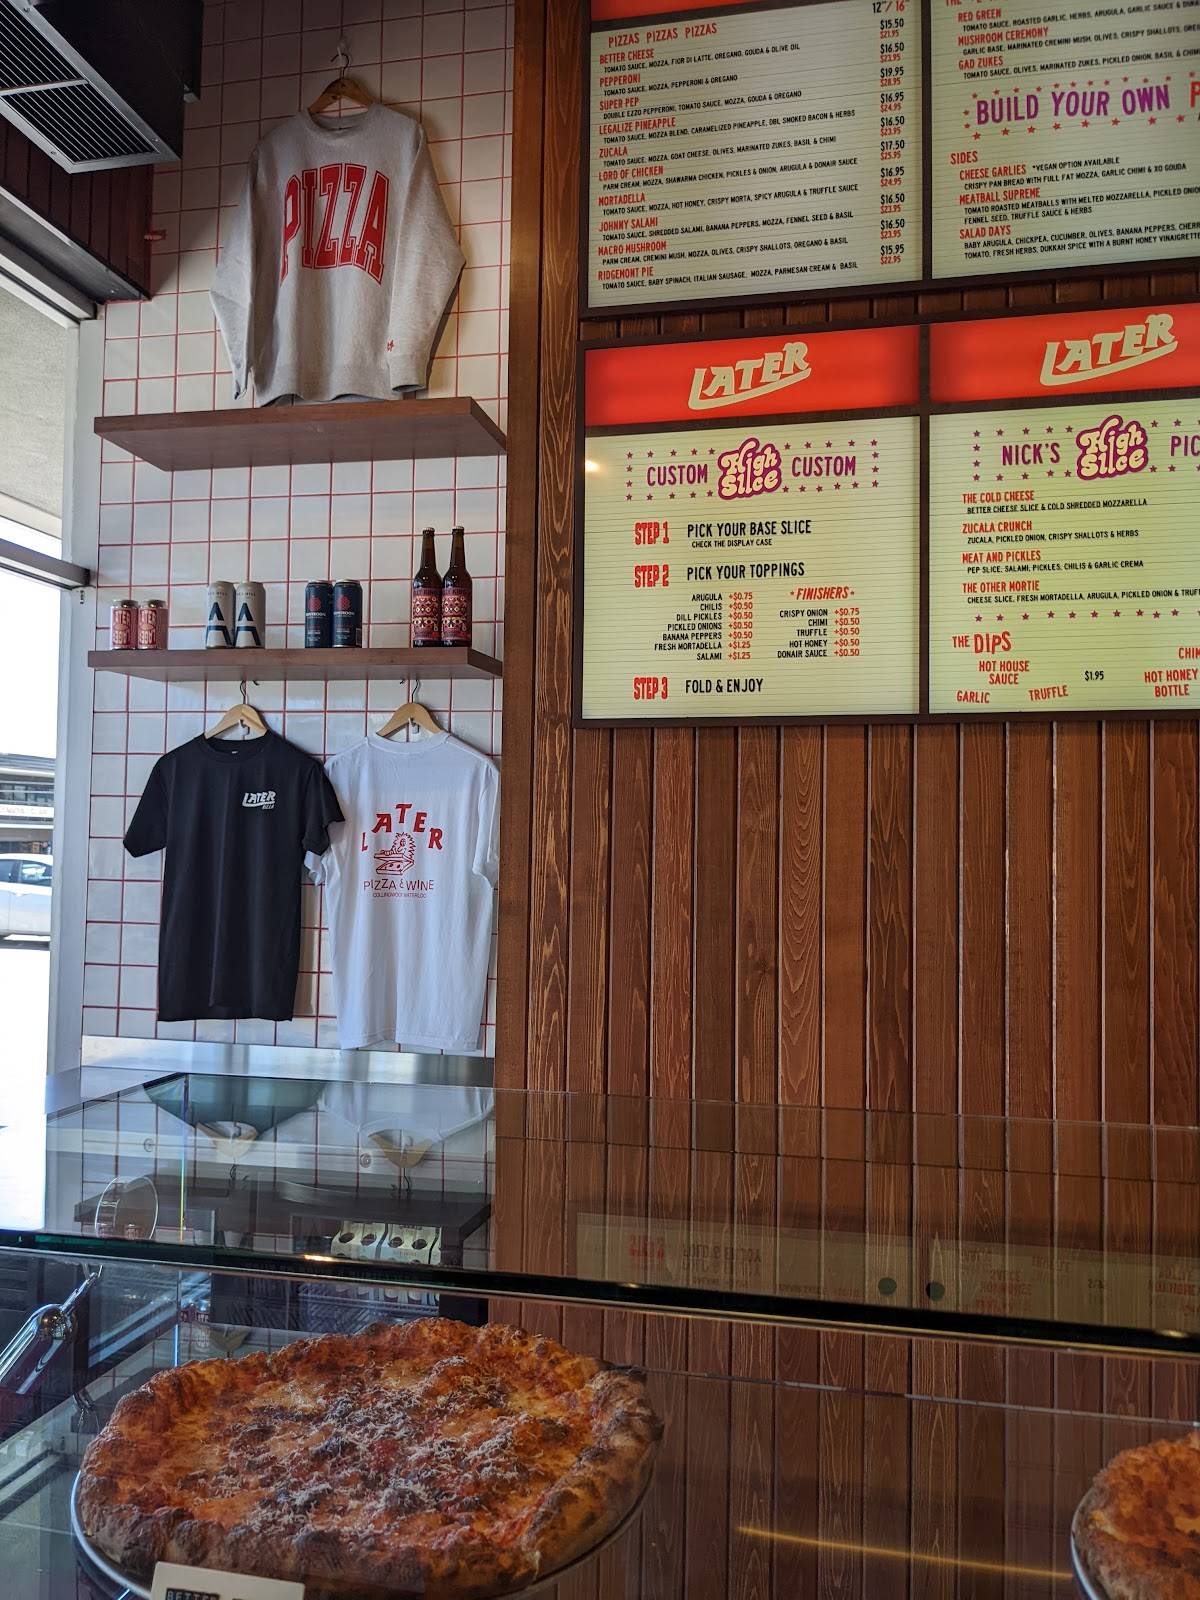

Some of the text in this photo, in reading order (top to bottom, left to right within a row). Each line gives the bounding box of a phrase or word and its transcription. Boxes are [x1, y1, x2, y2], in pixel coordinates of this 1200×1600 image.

[880, 18, 904, 29] $15.50
[608, 23, 717, 48] PIZZAS PIZZAS PIZZAS
[599, 48, 654, 64] BETTER CHEESE
[880, 67, 903, 77] $19.95
[599, 73, 640, 86] PEPPERONI
[977, 85, 1169, 124] BUILD YOUR OWN
[599, 117, 675, 134] LEGALIZE PINEAPPLE
[950, 151, 977, 164] SIDES
[598, 165, 663, 180] LORD OF CHICKEN
[959, 165, 1026, 179] CHEESE GARLIES
[598, 192, 645, 205] MORTADELLA
[959, 188, 1040, 204] MEATBALL SUPREME
[964, 215, 987, 224] FENNEL
[1011, 211, 1039, 220] TRUFFLE
[1042, 209, 1061, 218] SAUCE
[1070, 207, 1092, 215] HERBS
[280, 162, 390, 286] PIZZA
[600, 217, 658, 231] JOHNNY SALAMI
[959, 225, 1010, 239] SALAD DAYS
[598, 266, 653, 280] RIDGEMONT PIE
[1040, 314, 1178, 386] LATER
[688, 342, 812, 410] LATER
[1079, 417, 1143, 455] High
[720, 439, 778, 475] High
[1002, 443, 1060, 466] NICK'S
[791, 456, 856, 477] CUSTOM
[1080, 448, 1145, 477] Slice
[647, 464, 708, 487] CUSTOM
[721, 469, 779, 497] Slice
[963, 491, 1034, 503] THE COLD CHEESE
[967, 506, 991, 514] BETTER
[993, 505, 1017, 513] CHEESE
[1020, 504, 1038, 512] SLICE
[1066, 501, 1100, 510] SHREDDED
[1102, 499, 1147, 508] MOZZARELLA
[634, 521, 669, 545] STEP 1
[687, 521, 811, 537] PICK YOUR BASE SLICE
[962, 521, 1032, 534] ZUCALA CRUNCH
[995, 534, 1023, 543] PICKLED
[1048, 532, 1072, 541] CRISPY
[1074, 531, 1108, 540] SHALLOTS
[1116, 530, 1138, 538] HERBS
[962, 550, 1040, 563] MEAT AND PICKLES
[687, 563, 804, 580] PICK YOUR TOPPINGS
[967, 566, 980, 574] PEP
[1064, 562, 1086, 570] CHILIS
[1094, 561, 1118, 569] GARLIC
[1120, 560, 1143, 568] CREMA
[634, 564, 669, 588] STEP 2
[796, 586, 849, 600] FINISHERS
[963, 581, 1039, 594] THE OTHER MORTIE
[729, 592, 752, 601] +$0.75
[729, 602, 753, 610] +$0.50
[779, 608, 859, 618] CRISPY ONION +$0.75
[729, 612, 752, 620] +$0.50
[808, 617, 859, 627] CHIMI +$0.50
[728, 621, 752, 630] +$0.50
[797, 627, 859, 636] TRUFFLE +$0.50
[662, 631, 752, 641] BANANA PEPPERS +$0.50
[804, 639, 827, 647] HONEY
[834, 638, 859, 647] +$0.50
[952, 635, 970, 648] THE
[974, 631, 1011, 654] DIPS
[654, 641, 750, 650] FRESH MORTADELLA +$1.25
[728, 652, 750, 660] +$1.25
[777, 650, 802, 658] DONAIR
[834, 648, 859, 657] +$0.50
[978, 661, 1029, 671] HOT HOUSE
[989, 673, 1018, 685] SAUCE
[1084, 670, 1104, 681] $1.95
[1144, 669, 1198, 683] HOT HONEY
[633, 676, 668, 700] STEP 3
[685, 678, 762, 693] FOLD & ENJOY
[1154, 684, 1189, 697] BOTTLE
[956, 690, 989, 704] GARLIC
[1029, 685, 1067, 701] TRUFFLE
[242, 790, 276, 807] LATER
[362, 803, 443, 852] LATER
[364, 878, 397, 891] PIZZA
[406, 879, 434, 891] WINE
